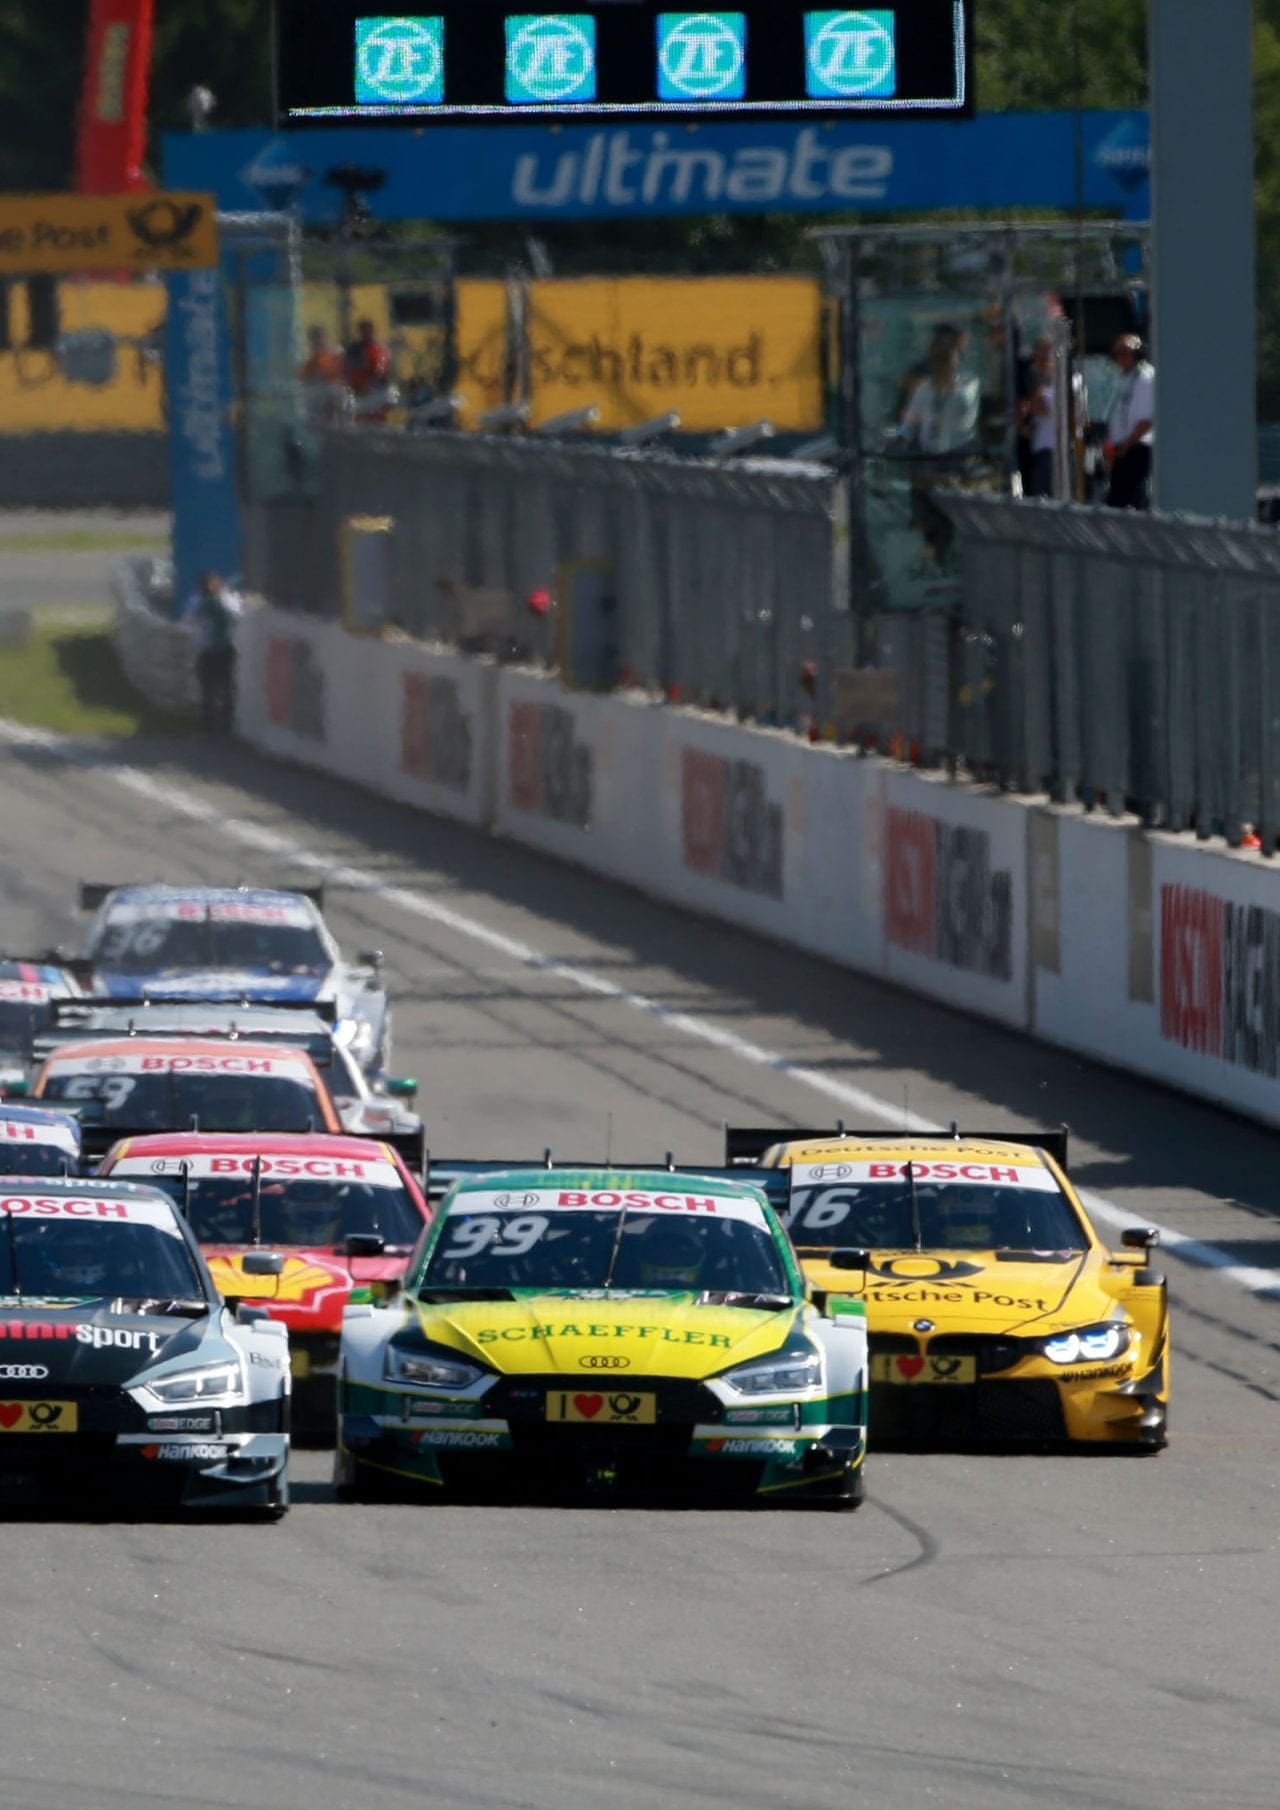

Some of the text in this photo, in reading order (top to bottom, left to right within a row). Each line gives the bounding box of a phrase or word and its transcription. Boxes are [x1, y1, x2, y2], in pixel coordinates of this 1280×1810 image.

[512, 127, 894, 205] ultimate
[141, 1057, 272, 1072] BOSCH
[210, 1157, 365, 1178] BOSCH
[868, 1163, 1020, 1183] BOSCH
[558, 1192, 718, 1213] BOSCH
[442, 1214, 551, 1259] 99
[973, 1289, 1049, 1313] Post
[477, 1322, 733, 1350] SCHAEFFLER
[180, 1417, 212, 1431] EDGE
